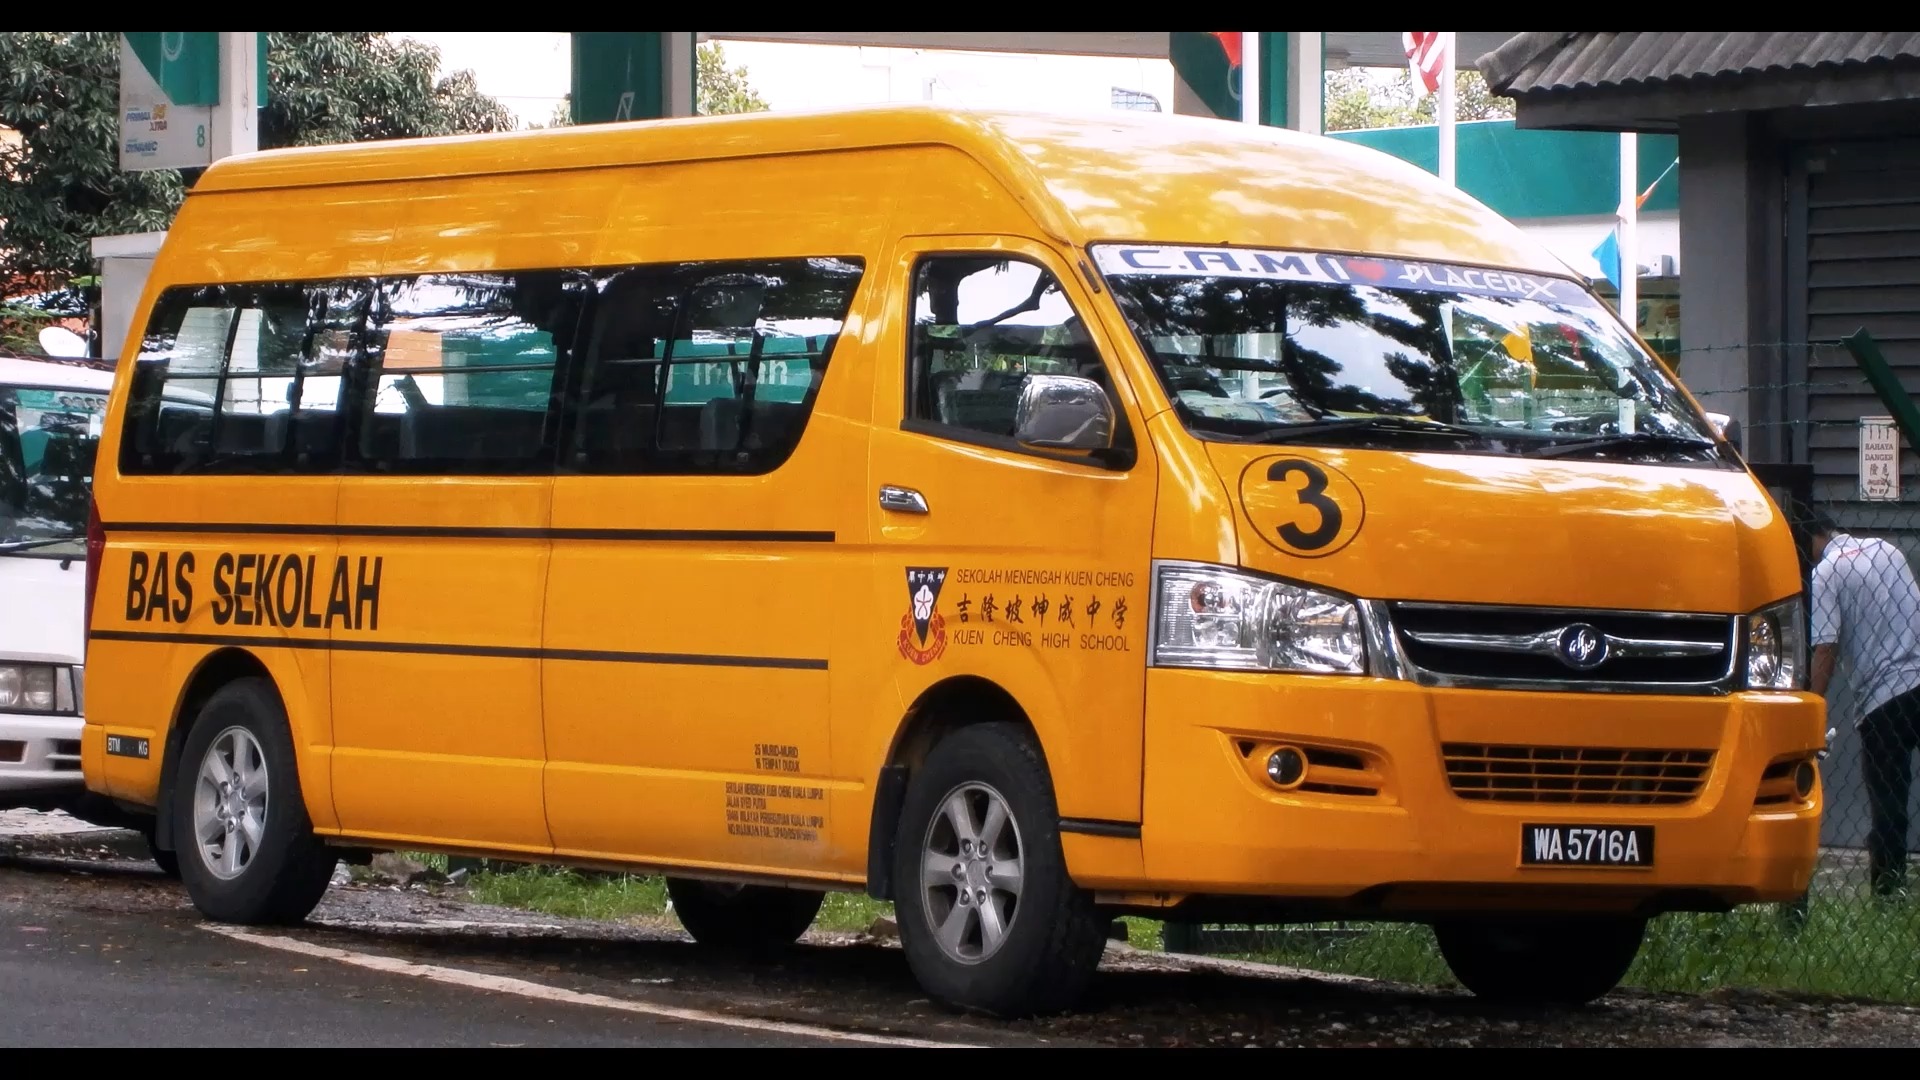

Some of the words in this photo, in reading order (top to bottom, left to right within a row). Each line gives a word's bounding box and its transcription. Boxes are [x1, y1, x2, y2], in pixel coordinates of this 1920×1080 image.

[197, 125, 205, 147] 8
[1267, 459, 1342, 550] 3
[957, 569, 1001, 584] SEKOLAH
[1005, 570, 1061, 585] MENENGAH
[1064, 571, 1092, 586] KUEN
[1096, 572, 1134, 587] CHENG
[126, 551, 195, 624] BAS
[211, 552, 383, 630] SEKOLAH
[953, 630, 984, 645] KUEN
[993, 631, 1032, 647] CHENG
[1041, 633, 1070, 648] HIGH
[1080, 634, 1130, 651] SCHOOL
[108, 737, 121, 752] BTM
[138, 741, 148, 756] KG
